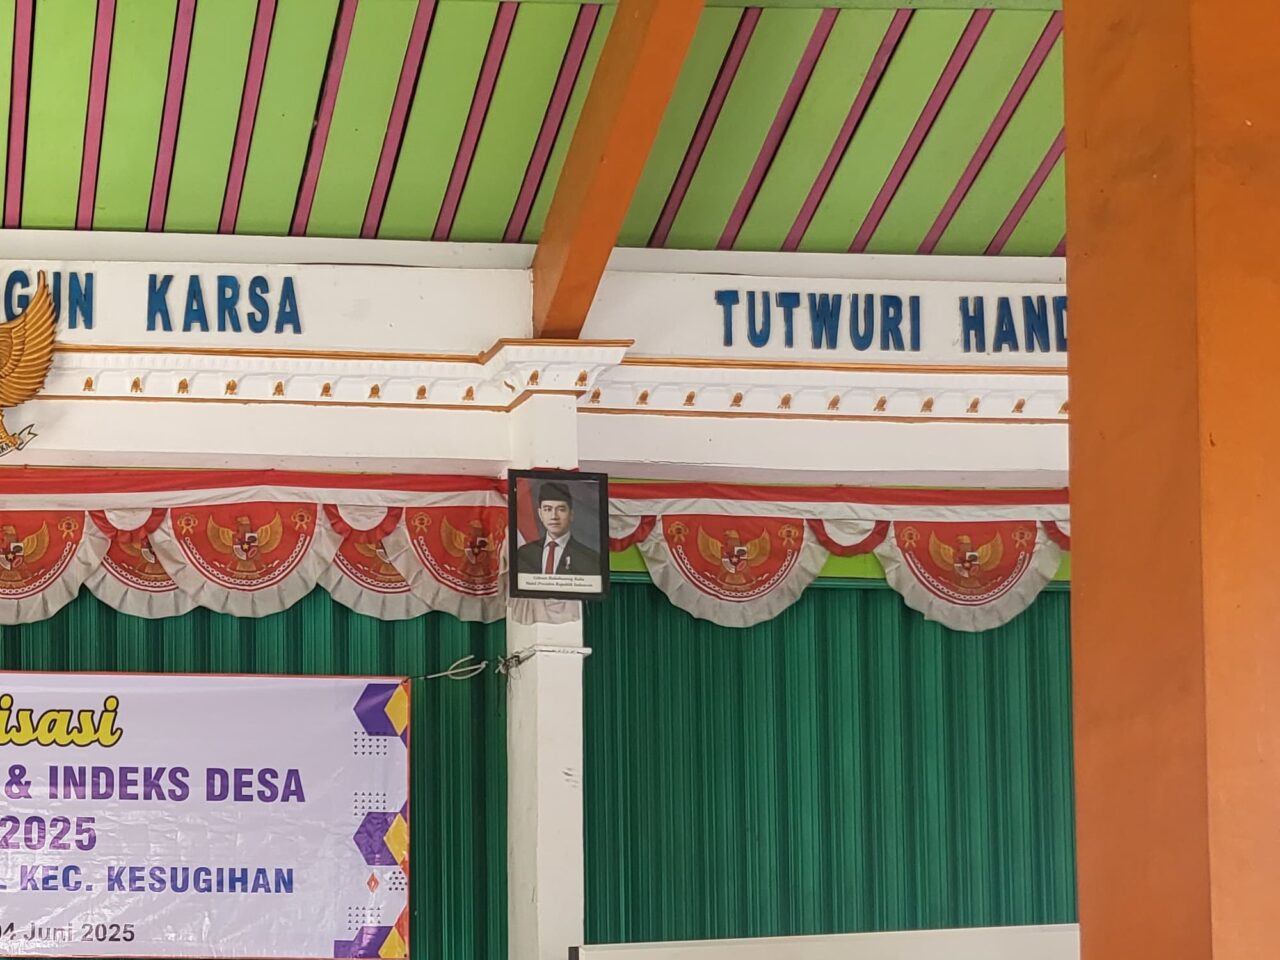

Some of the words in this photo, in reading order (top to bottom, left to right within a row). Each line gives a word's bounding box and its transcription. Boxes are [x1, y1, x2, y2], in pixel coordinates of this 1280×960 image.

[146, 273, 303, 334] KARSA
[715, 290, 920, 351] TUTWURI
[4, 764, 33, 800] &
[49, 765, 190, 801] INDEKS
[206, 767, 306, 803] DESA
[20, 864, 93, 892] KEC.
[107, 866, 295, 894] KESUGIHAN
[23, 922, 73, 942] Juni
[81, 923, 136, 942] 2025
